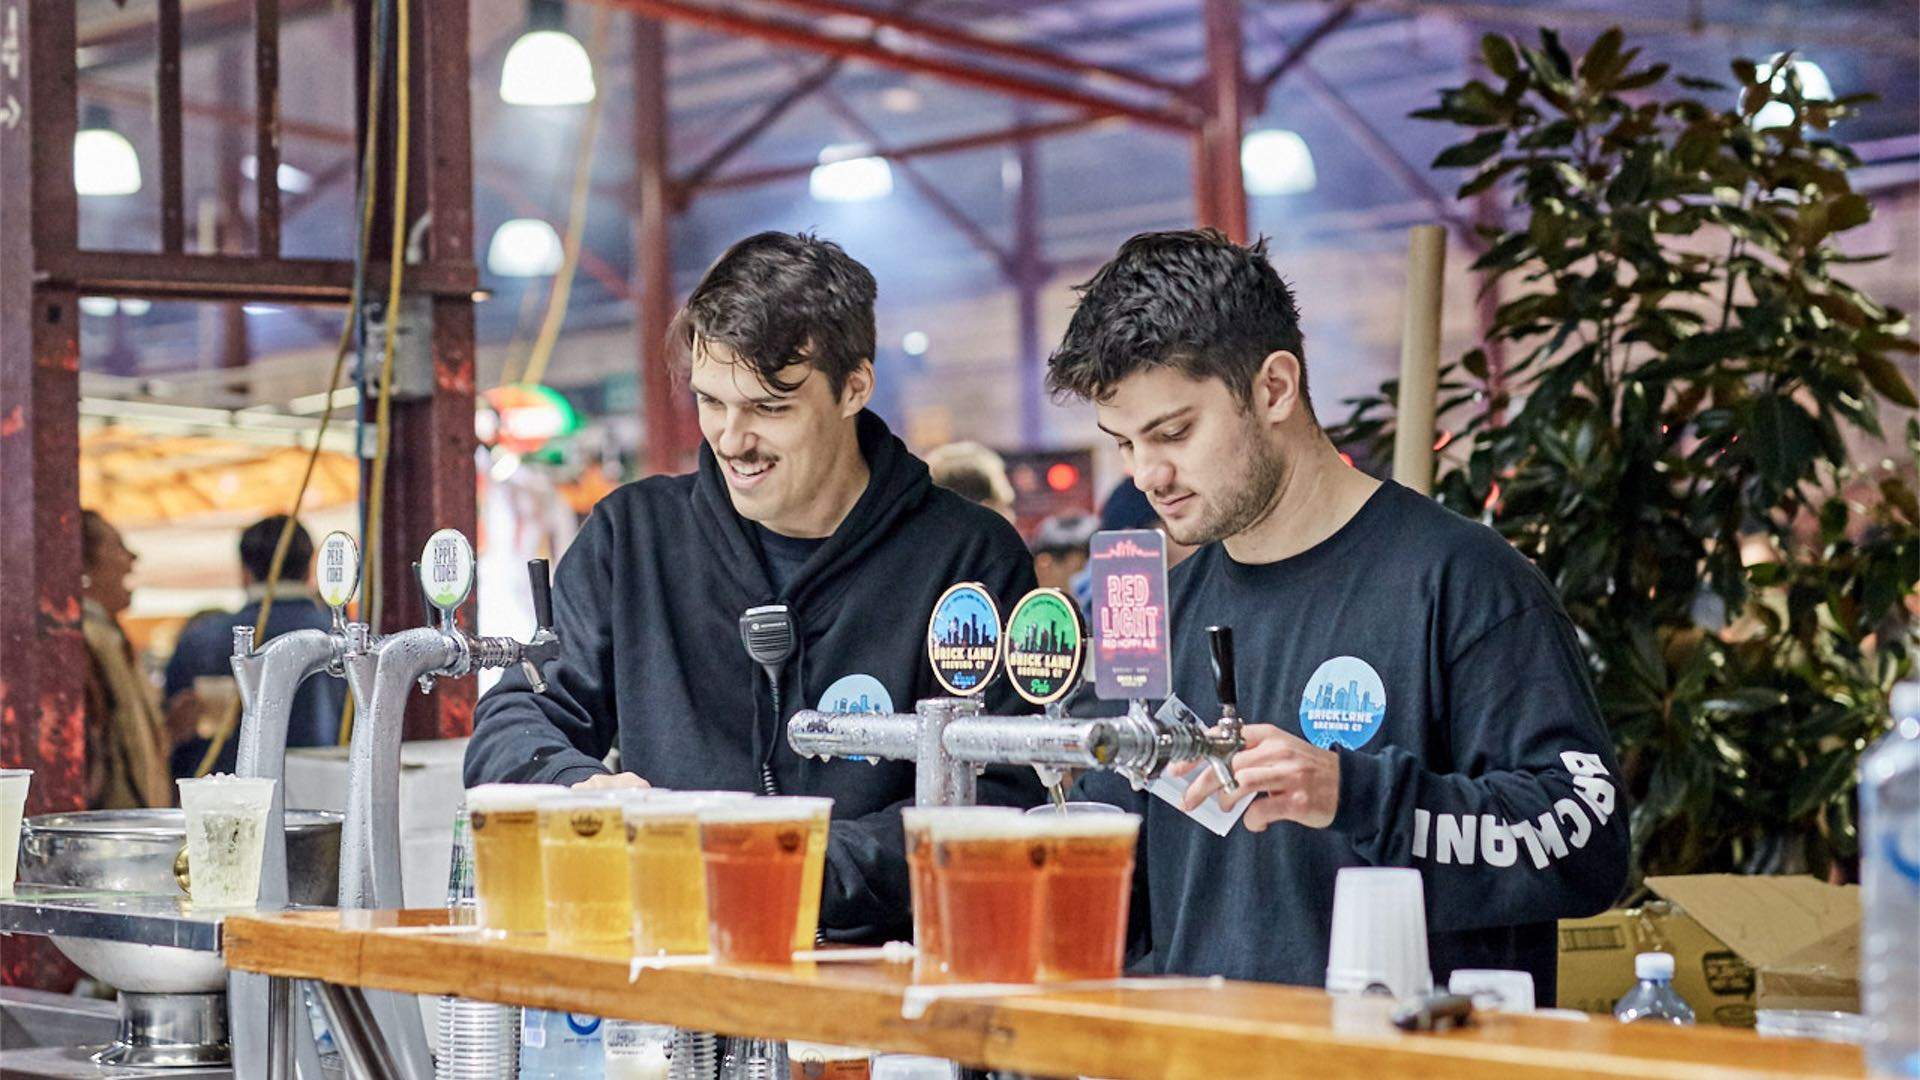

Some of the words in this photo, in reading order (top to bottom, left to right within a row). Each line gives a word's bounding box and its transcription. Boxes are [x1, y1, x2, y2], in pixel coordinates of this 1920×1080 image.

[433, 546, 457, 564] APPLE
[327, 567, 343, 582] CIDER
[433, 564, 457, 582] CIDER
[1107, 574, 1149, 607] RED
[1101, 606, 1158, 638] LIGHT
[1142, 638, 1157, 649] ALE
[934, 646, 965, 661] BRICK
[967, 646, 994, 661] LANE
[1010, 652, 1043, 667] BRICK
[1044, 654, 1072, 669] LANE
[1307, 709, 1341, 721] BRICK
[1342, 711, 1373, 724] LANE
